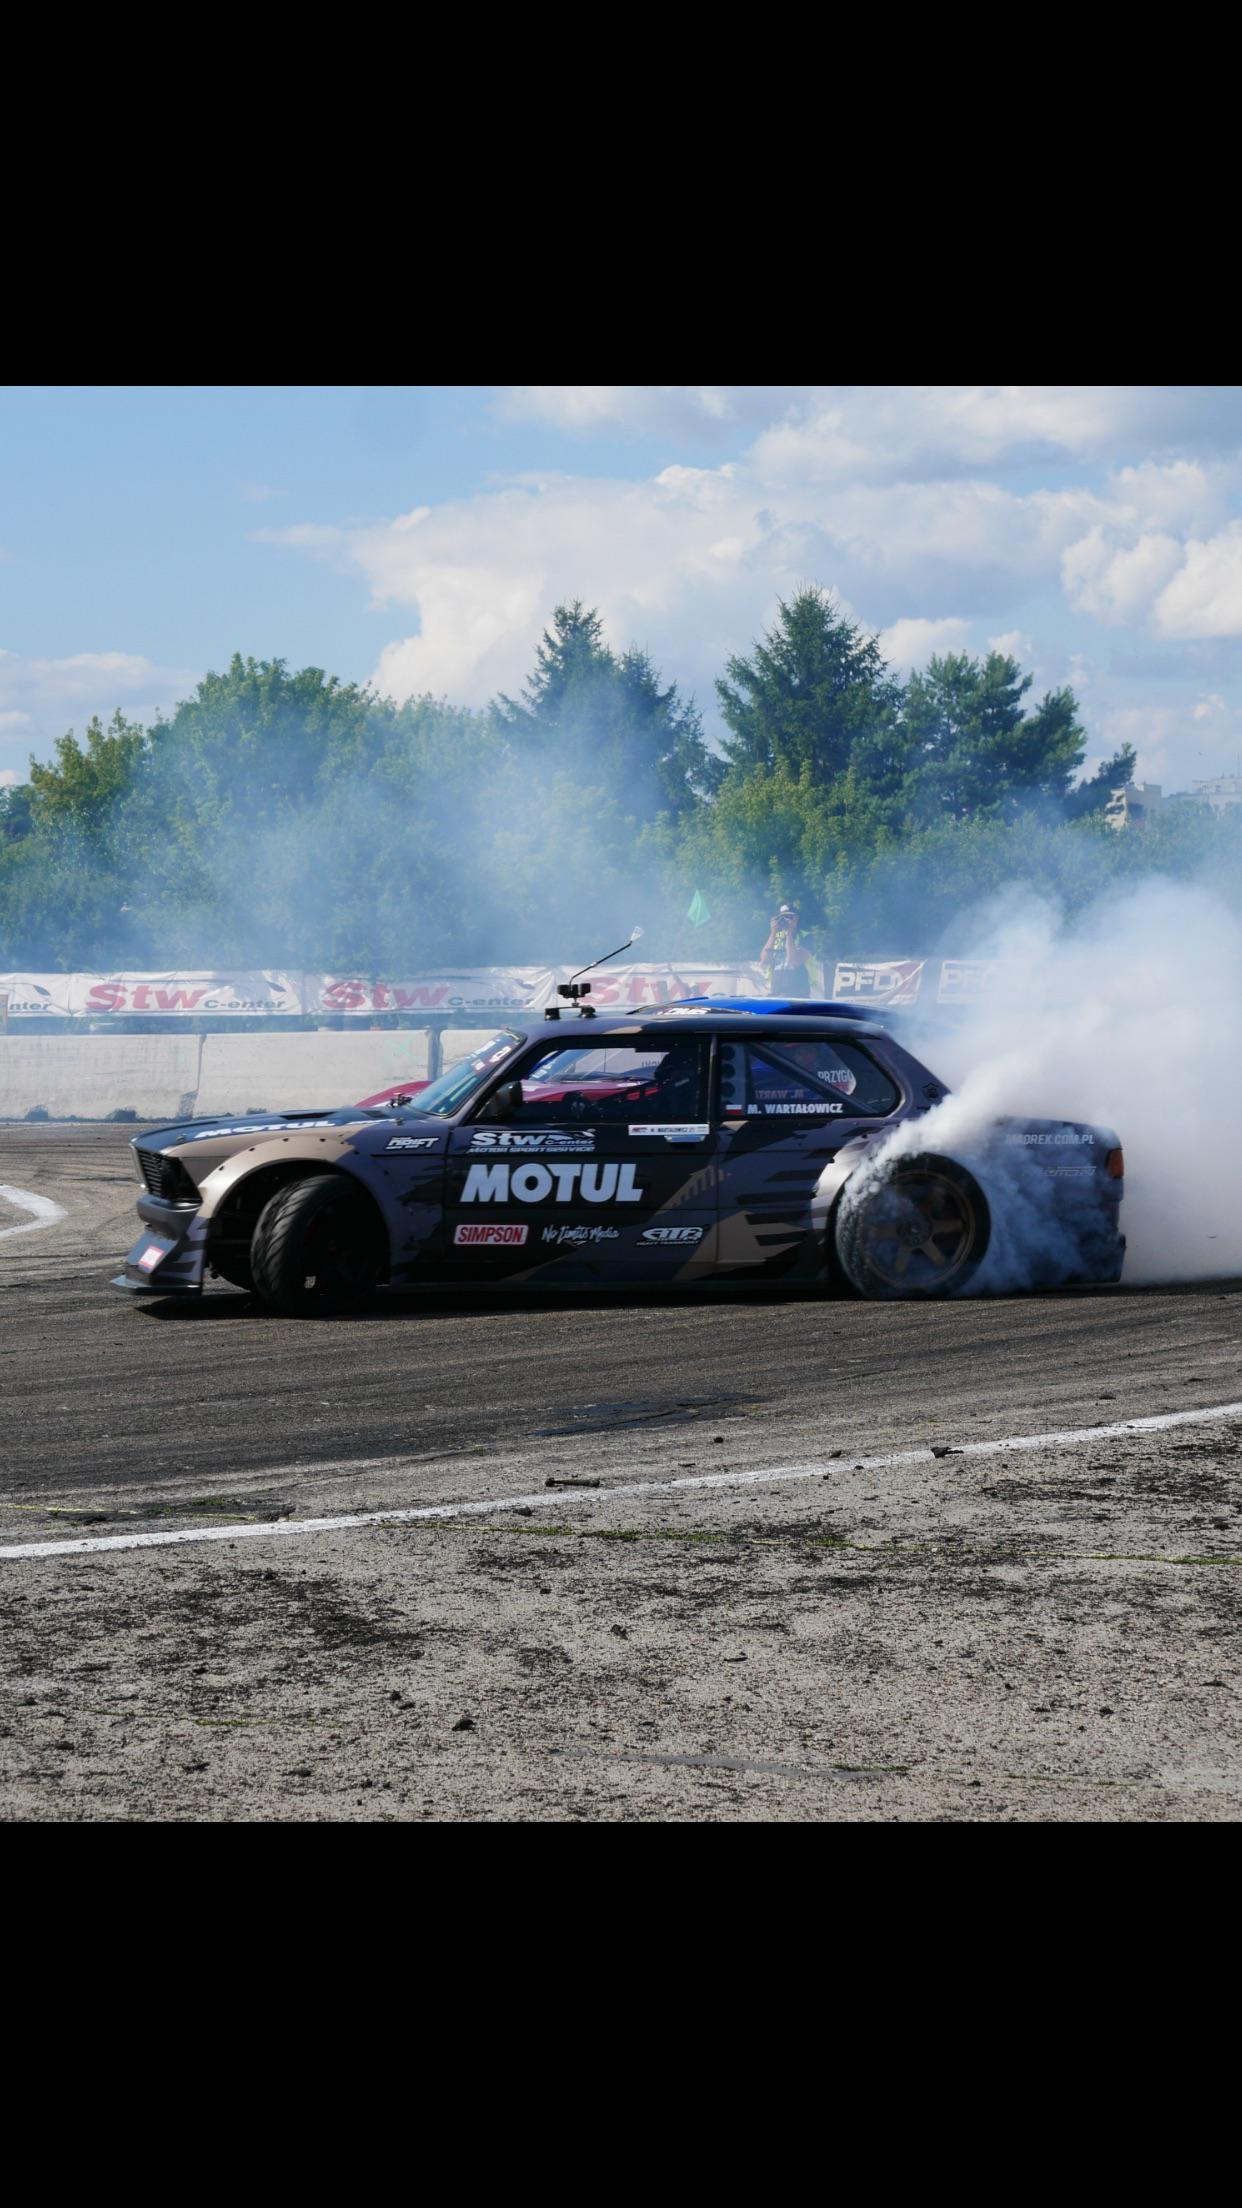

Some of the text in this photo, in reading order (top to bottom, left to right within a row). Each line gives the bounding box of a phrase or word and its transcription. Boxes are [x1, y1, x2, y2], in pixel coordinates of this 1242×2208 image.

[86, 983, 286, 1010] Stw C-enter
[323, 981, 534, 1009] Stw C-enter
[580, 976, 712, 1005] Stw
[8, 1001, 52, 1010] nter
[747, 1103, 843, 1114] M. WARTAŁOWICZ
[194, 1120, 336, 1139] MOTUL
[470, 1132, 546, 1145] Stw
[460, 1163, 644, 1203] MOTUL
[457, 1226, 524, 1243] SIMPSON
